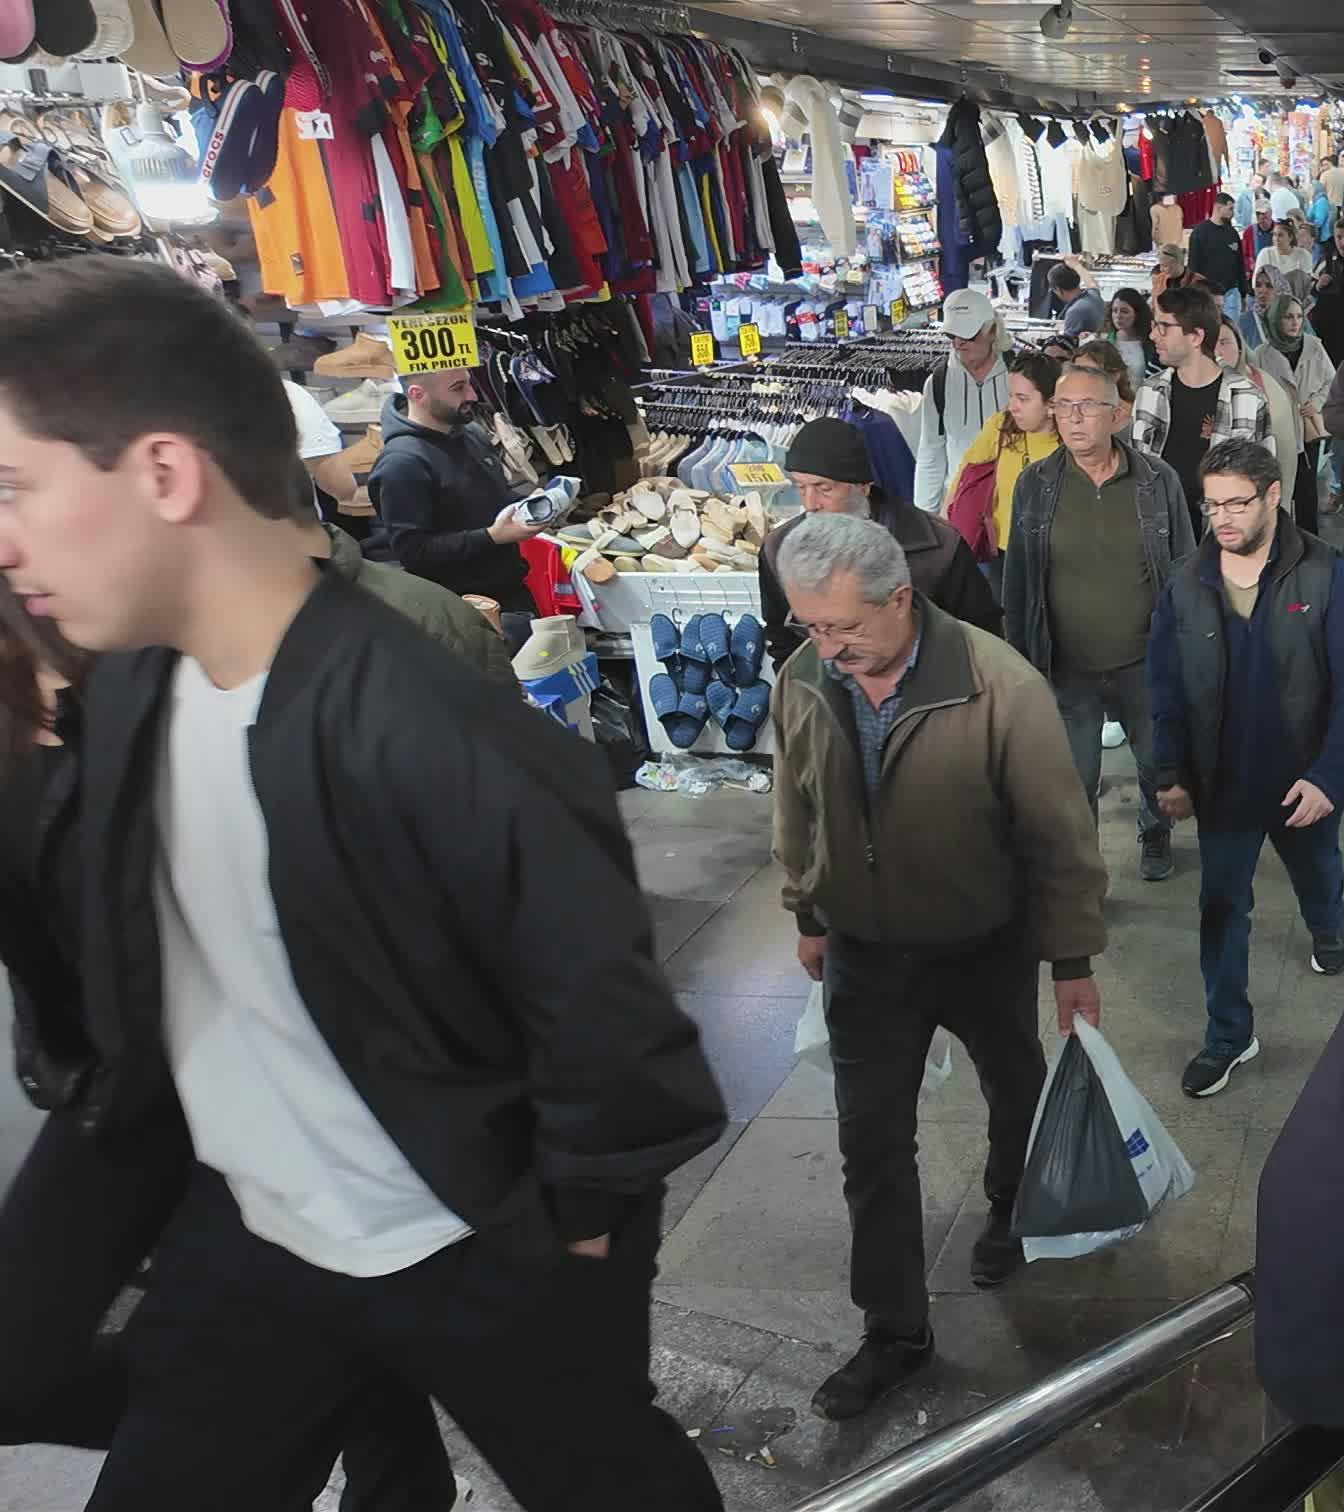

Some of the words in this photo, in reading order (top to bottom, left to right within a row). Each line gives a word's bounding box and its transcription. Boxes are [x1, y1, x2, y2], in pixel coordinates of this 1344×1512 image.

[400, 327, 455, 360] 300
[457, 343, 472, 354] TL
[409, 362, 429, 372] FIX
[431, 358, 469, 370] PRICE
